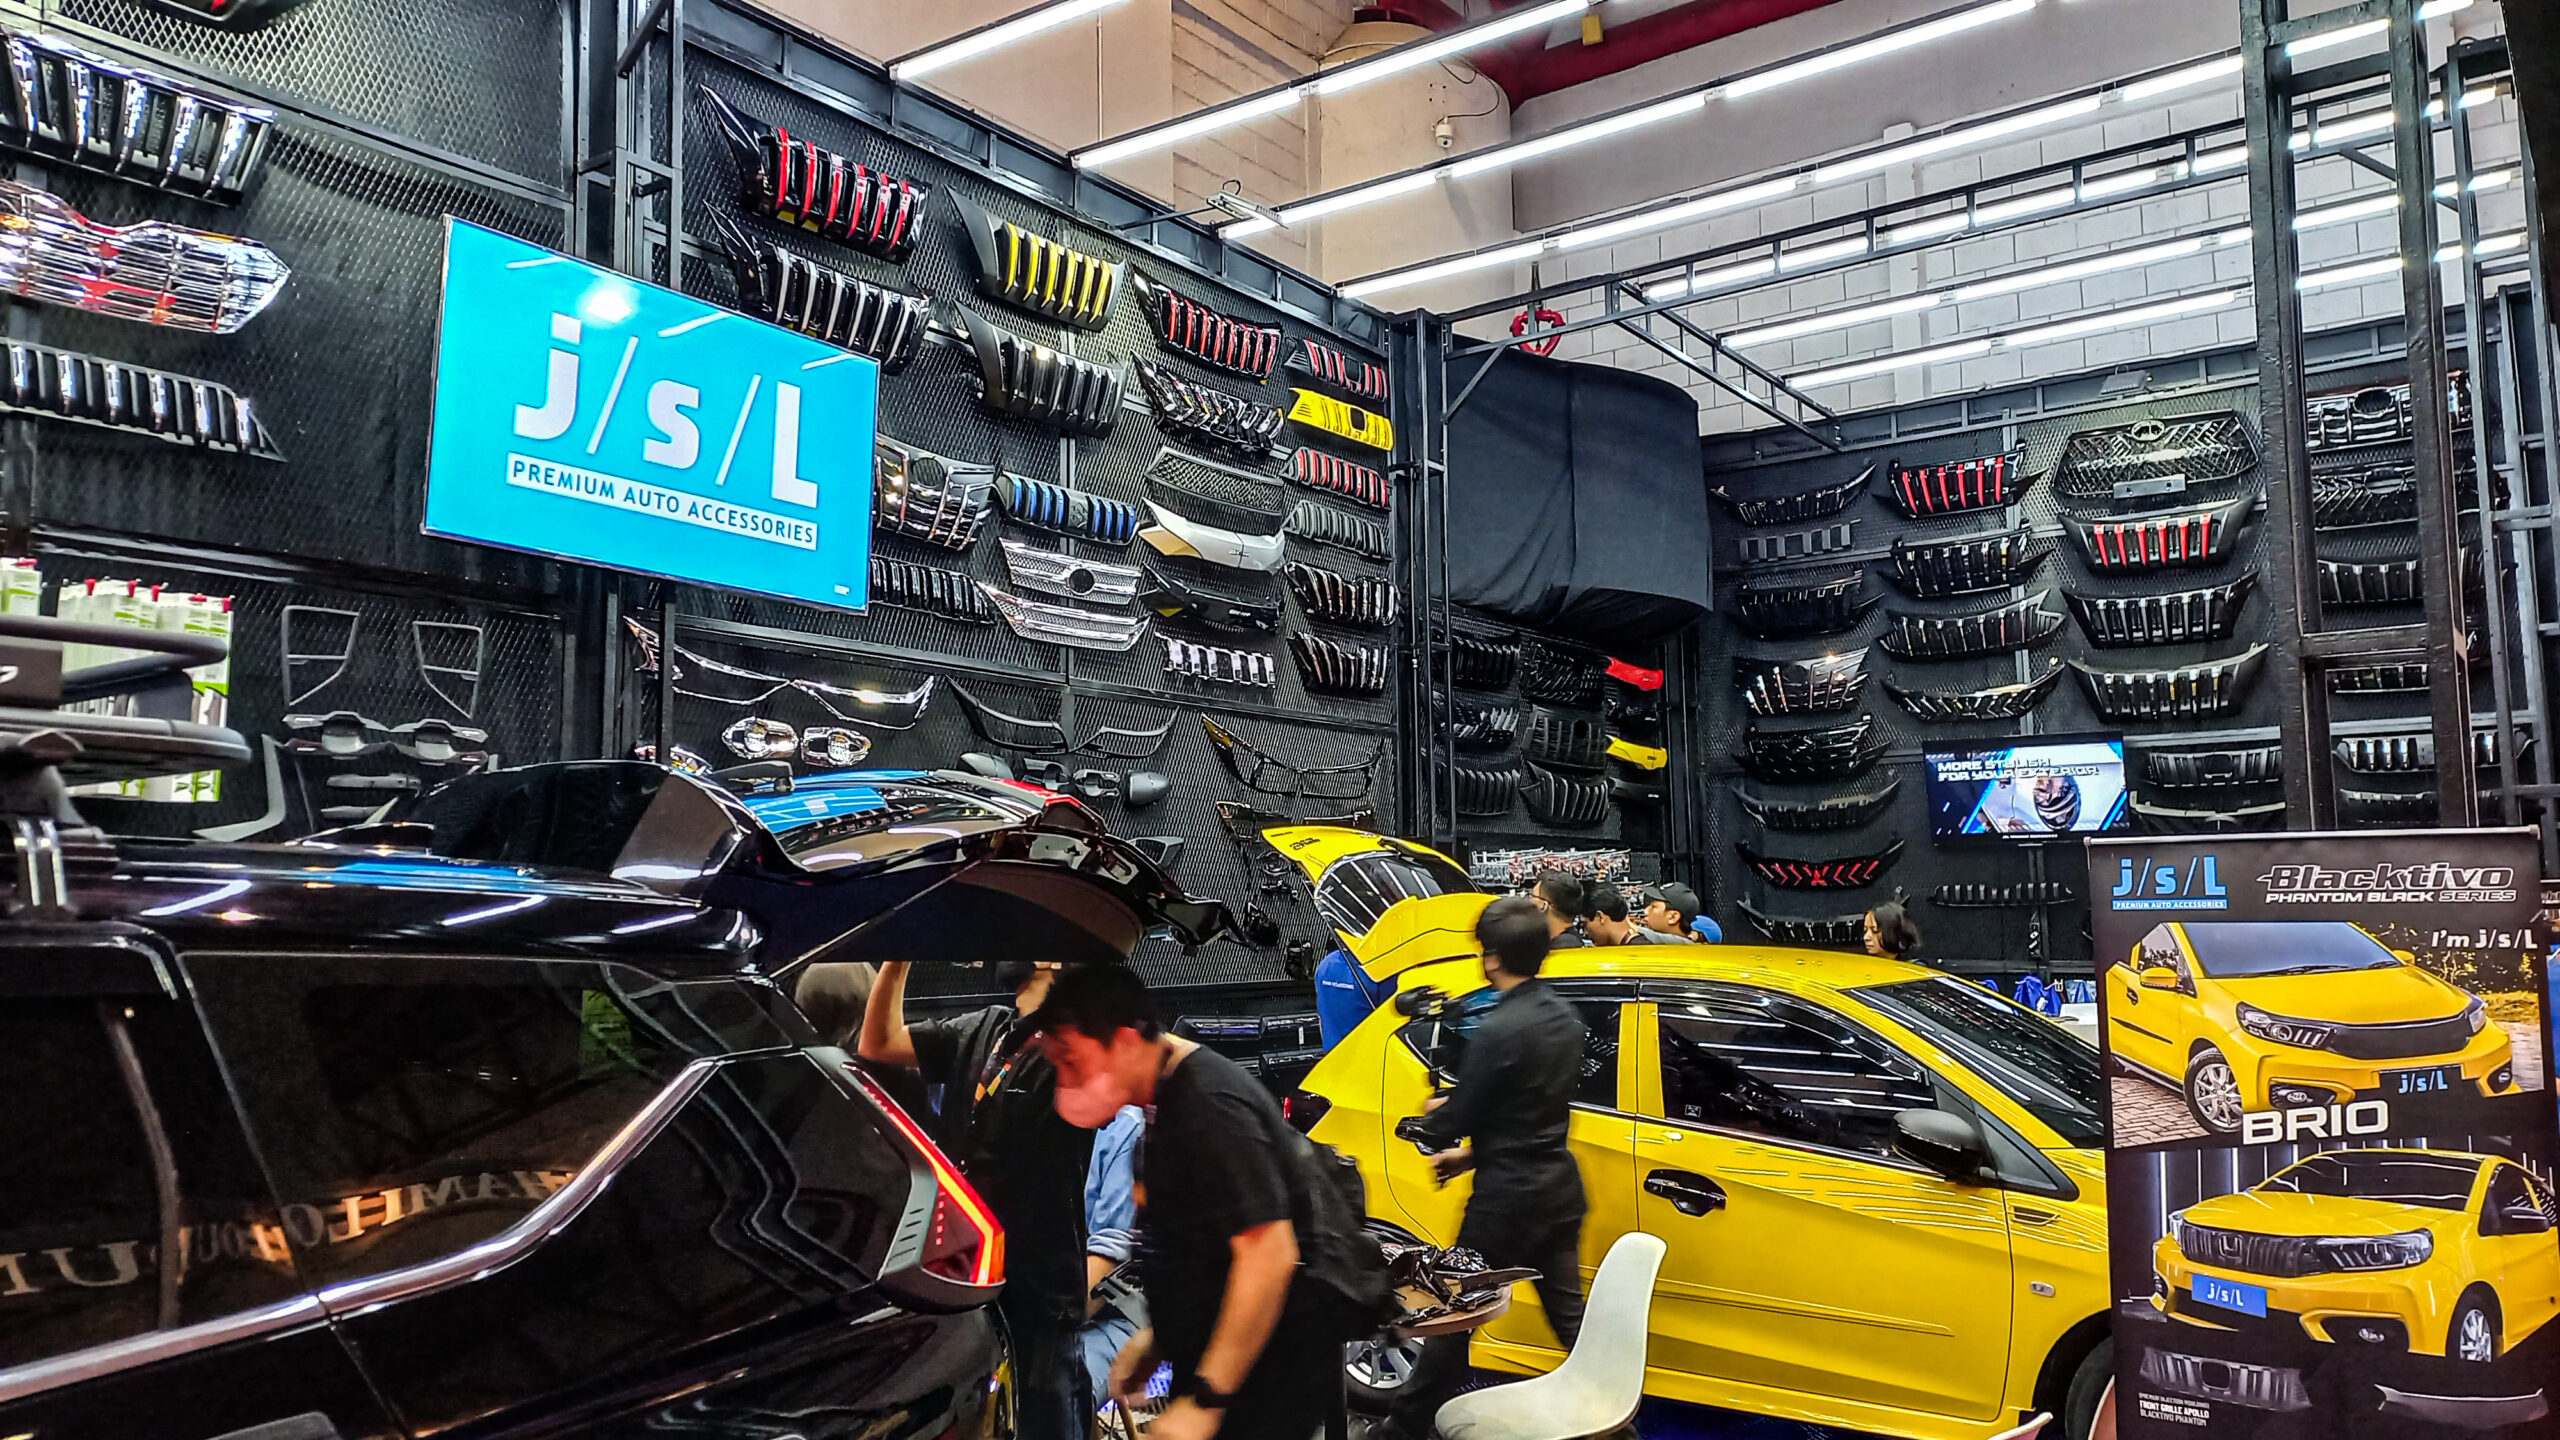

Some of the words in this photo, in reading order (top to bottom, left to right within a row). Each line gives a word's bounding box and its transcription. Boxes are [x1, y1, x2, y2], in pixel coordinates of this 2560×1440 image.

[512, 311, 818, 509] j/s/L
[512, 460, 616, 500] PREMIUM
[623, 486, 680, 514] AUTO
[687, 503, 814, 544] ACCESSORIES
[1937, 760, 1982, 772] MORE
[1937, 771, 1971, 782] FOR
[1972, 769, 2015, 781] YOUR
[2112, 856, 2227, 897] j/s/L
[2256, 862, 2514, 891] Blacktivo
[2116, 901, 2150, 909] PREMIUM
[2152, 901, 2172, 909] AUTO
[2265, 891, 2364, 903] PHANTOM
[2366, 891, 2434, 902] BLACK
[2438, 889, 2517, 902] SERIES
[2431, 930, 2470, 949] I'm
[2474, 928, 2539, 950] j/s/L
[2397, 1067, 2448, 1094] j/s/L
[2242, 1100, 2390, 1146] BRIO
[2206, 1282, 2245, 1307] j/s/L
[2139, 1400, 2160, 1411] FRONT
[2160, 1403, 2183, 1415] GRILLE
[2183, 1406, 2210, 1419] APOLLO
[2140, 1409, 2174, 1421] BLACKTIVO
[2174, 1414, 2207, 1427] PHANTOM
